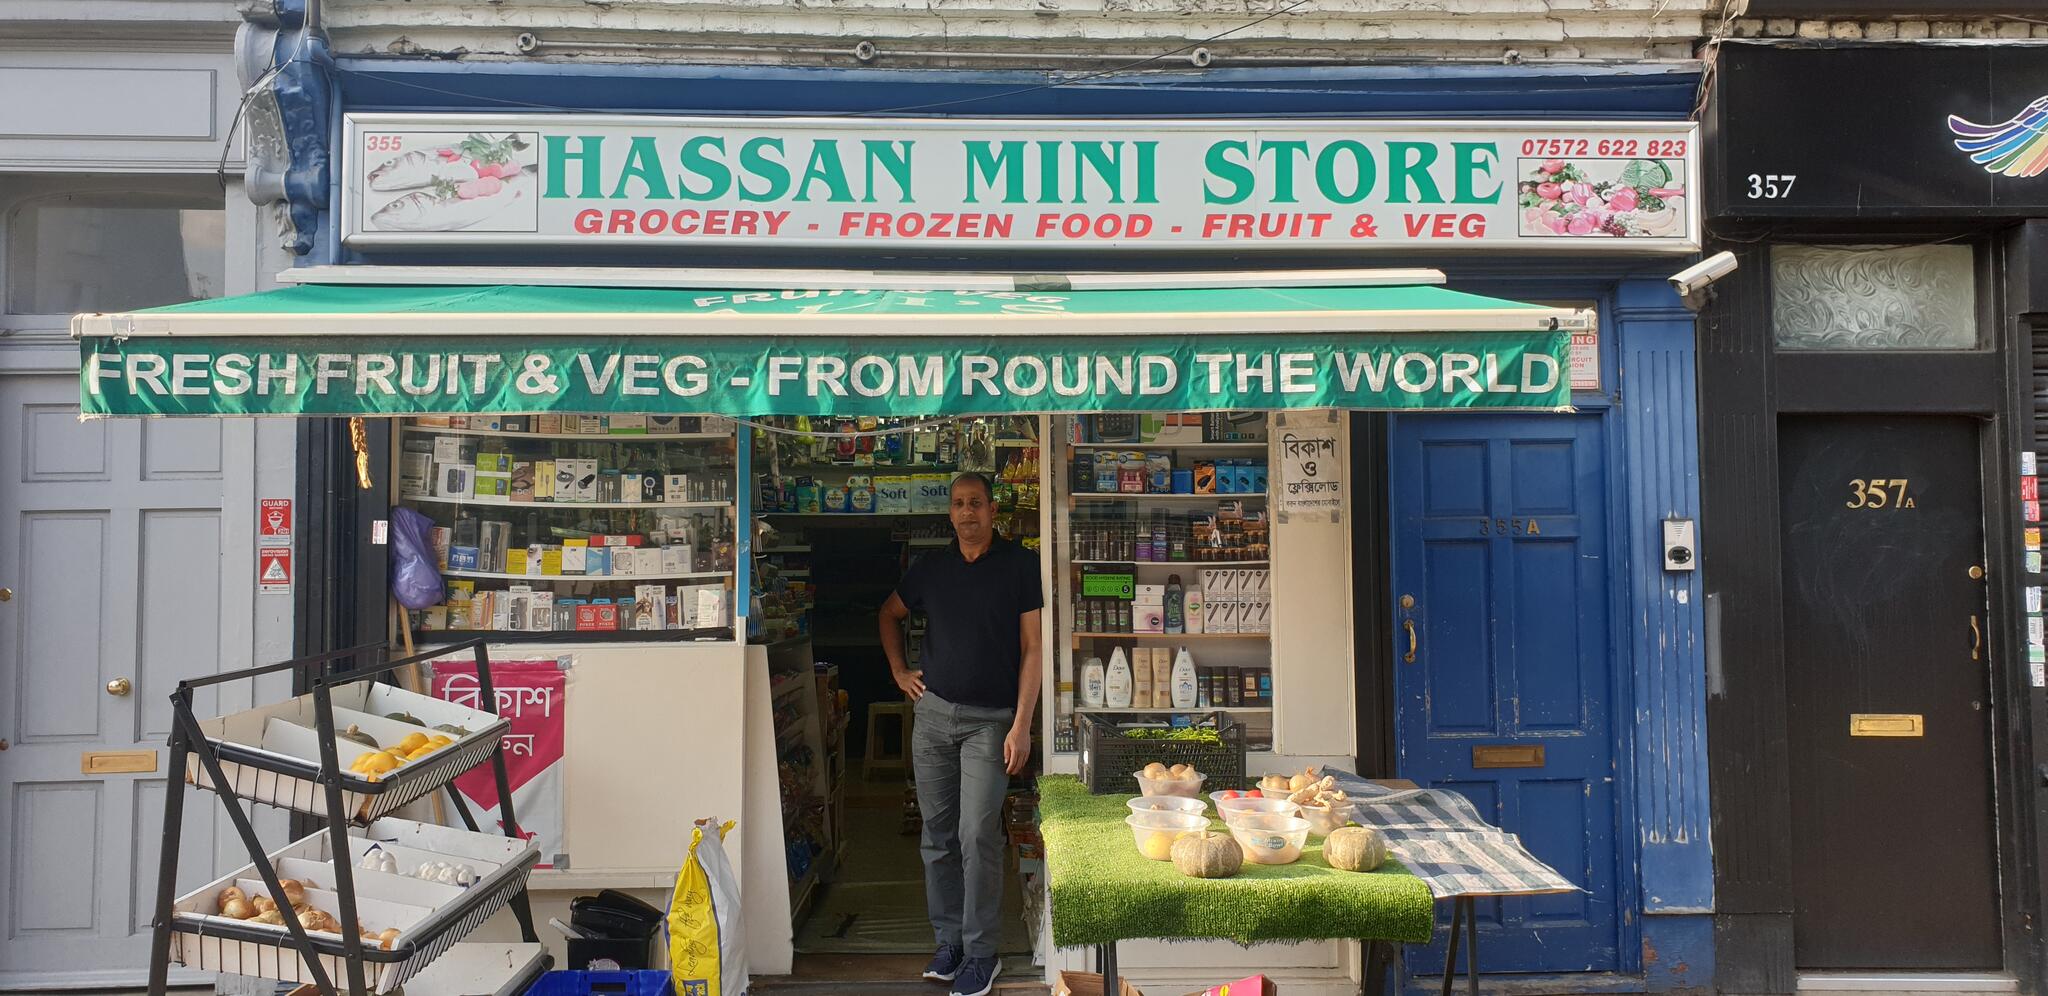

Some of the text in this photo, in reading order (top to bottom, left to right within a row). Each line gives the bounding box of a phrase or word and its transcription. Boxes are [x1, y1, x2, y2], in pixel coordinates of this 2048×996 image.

[366, 135, 402, 151] 355
[1521, 139, 1687, 157] 07572 622 823
[543, 135, 1503, 206] HASSAN MINI STORE
[1747, 173, 1797, 199] 357
[574, 209, 789, 236] GROCERY
[839, 212, 1014, 238] FROZEN
[1035, 213, 1153, 238] FOOD
[1201, 213, 1333, 239] FRUIT
[1349, 214, 1378, 238] &
[1403, 213, 1487, 239] VEG
[86, 352, 298, 396] FRESH
[315, 353, 501, 396] FRUIT
[516, 354, 559, 395] &
[578, 353, 709, 396] VEG
[767, 355, 944, 397] FROM
[962, 355, 1178, 397] ROUND
[1197, 353, 1316, 394] THE
[1335, 351, 1560, 394] WORLD
[1281, 433, 1336, 459] বিকাশ
[1300, 461, 1317, 477] ও
[881, 487, 908, 499] Soft
[921, 485, 948, 496] Soft
[1479, 518, 1540, 535] 355A
